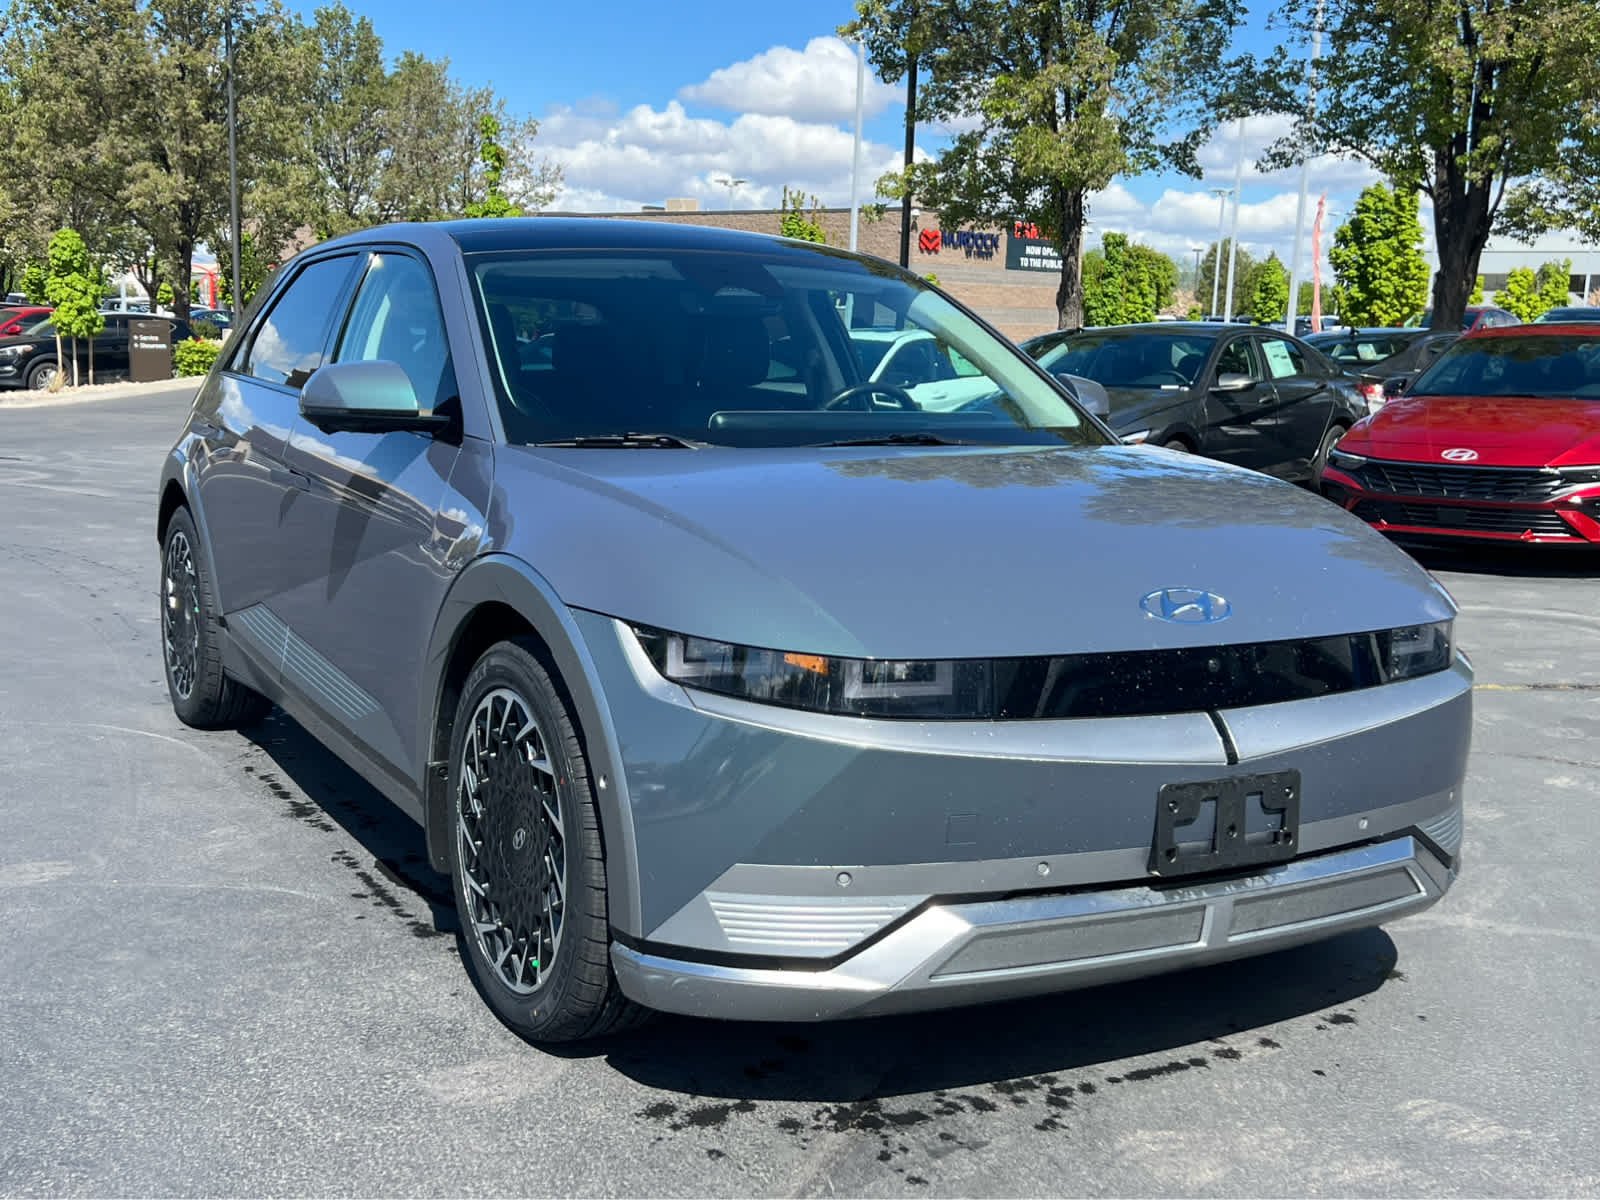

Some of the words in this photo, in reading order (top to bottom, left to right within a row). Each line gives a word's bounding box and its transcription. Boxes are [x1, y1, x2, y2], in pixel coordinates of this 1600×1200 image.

[1025, 245, 1042, 255] NOW
[1020, 257, 1029, 267] TO
[1029, 257, 1042, 268] THE
[1042, 258, 1064, 270] PUBLIC
